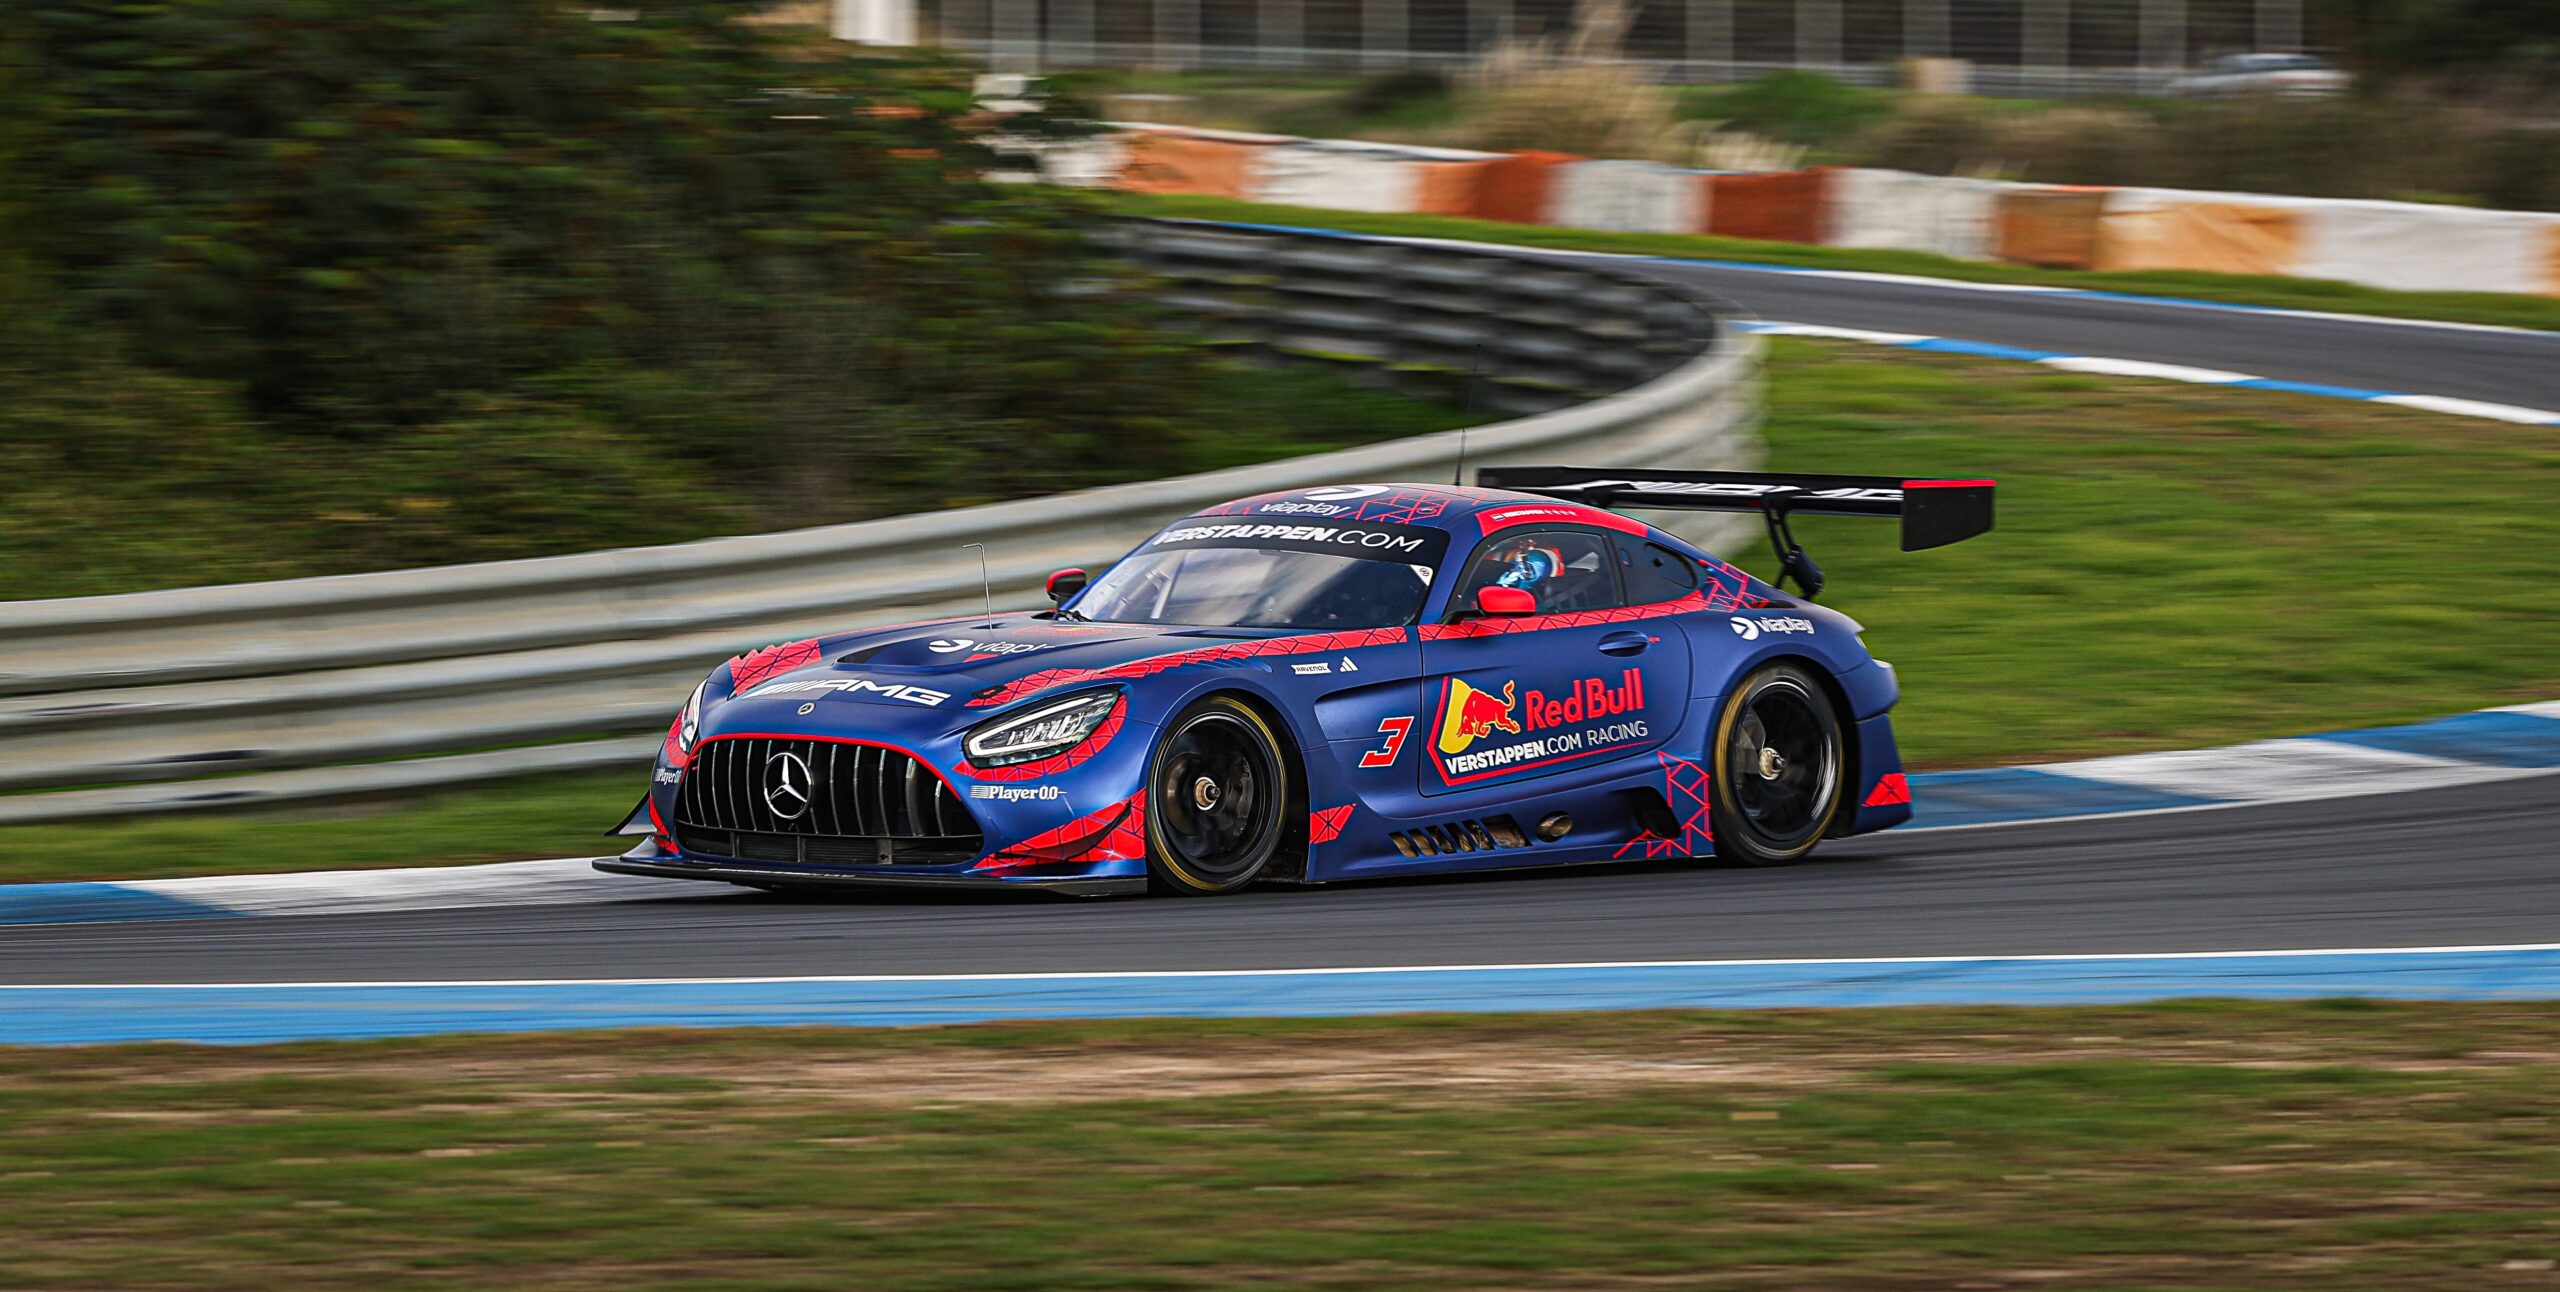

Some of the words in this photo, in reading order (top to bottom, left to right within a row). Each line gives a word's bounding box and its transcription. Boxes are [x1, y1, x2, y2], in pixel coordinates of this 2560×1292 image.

[1260, 501, 1351, 515] viaplay
[1152, 524, 1424, 552] VERSTAPPEN.COM
[1754, 616, 1815, 634] viaplay
[808, 679, 951, 706] AMG
[1524, 679, 1584, 732] Red
[1585, 667, 1645, 719] Bull
[1358, 716, 1415, 769] 3
[1445, 733, 1582, 775] VERSTAPPEN.COM
[1587, 720, 1649, 746] RACING
